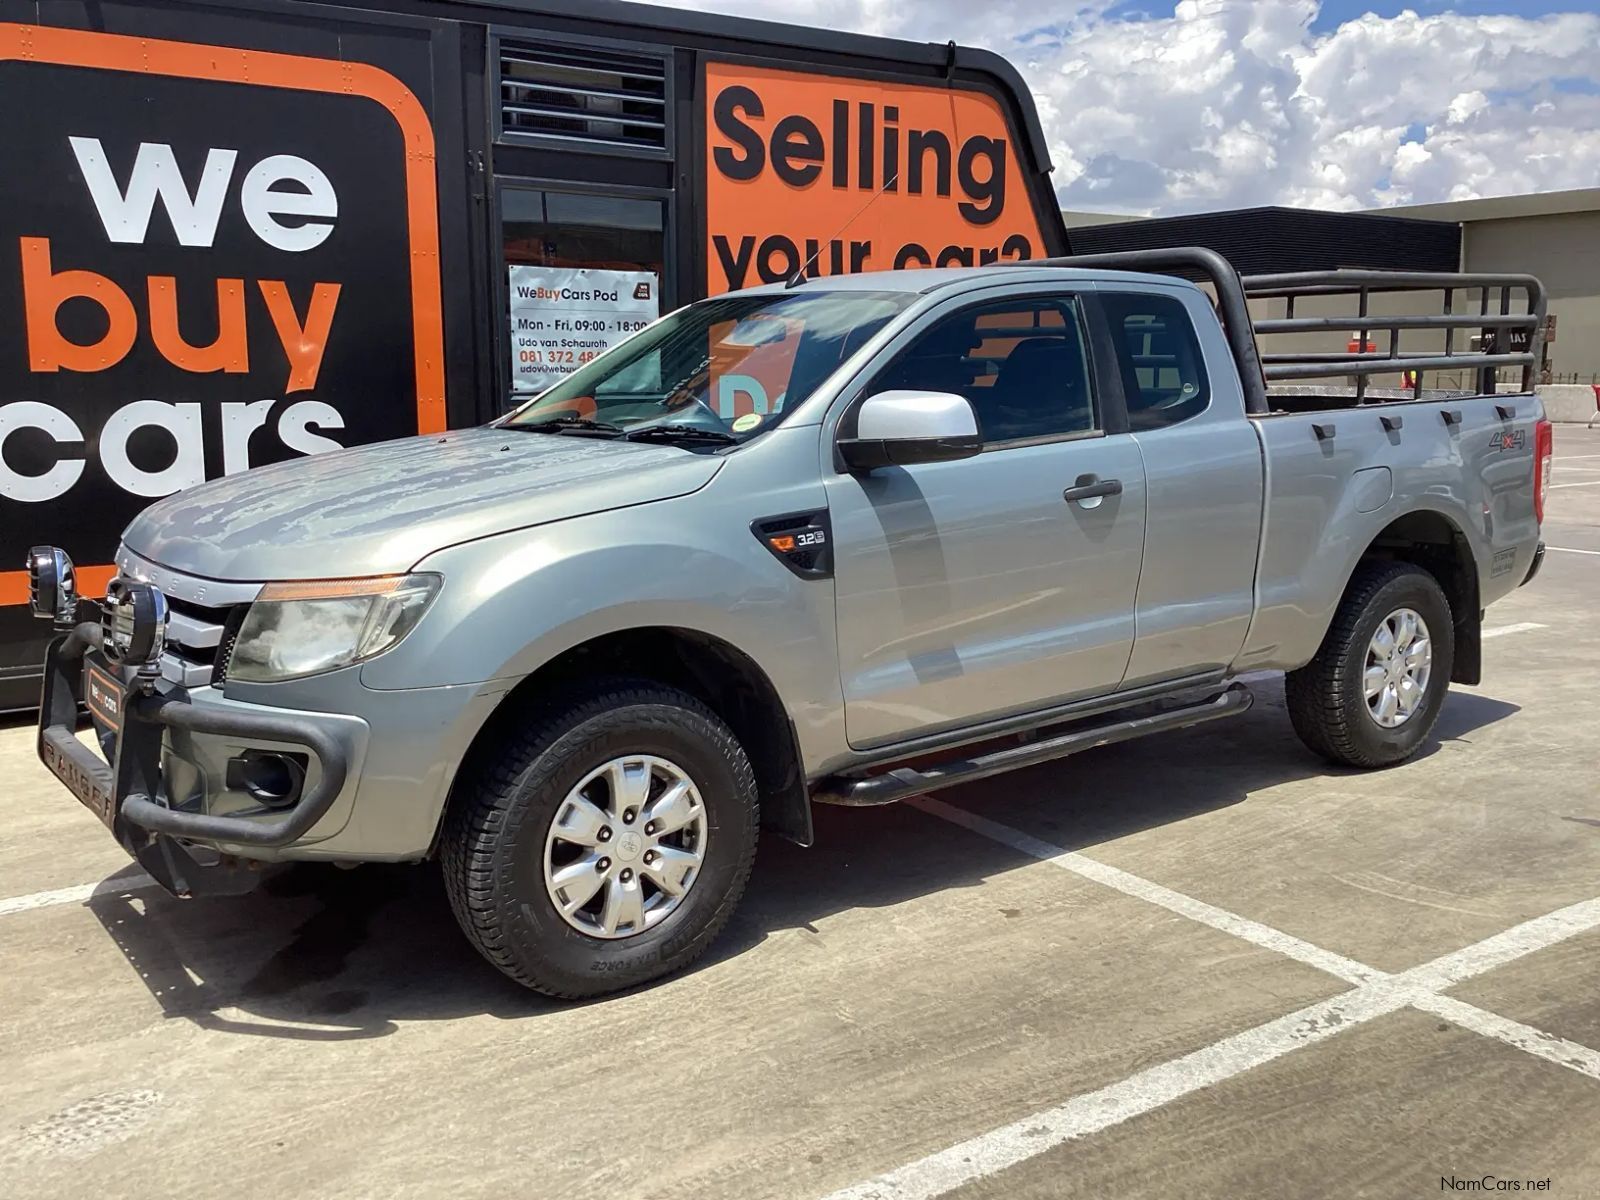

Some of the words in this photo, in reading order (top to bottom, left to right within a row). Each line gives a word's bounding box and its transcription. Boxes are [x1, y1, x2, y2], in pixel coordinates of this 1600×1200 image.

[713, 85, 1006, 225] Selling
[68, 136, 338, 252] we
[712, 235, 871, 292] your
[517, 286, 591, 302] WeBuyCars
[593, 290, 618, 301] Pod
[20, 237, 342, 394] buy
[518, 319, 544, 330] Mon
[554, 320, 573, 331] Fri,
[574, 320, 606, 331] 09:00
[518, 338, 538, 347] Udo
[560, 338, 608, 348] Schauroth
[520, 350, 542, 362] 081
[548, 351, 574, 363] 372
[0, 399, 345, 502] cars
[1488, 429, 1526, 452] 4x4
